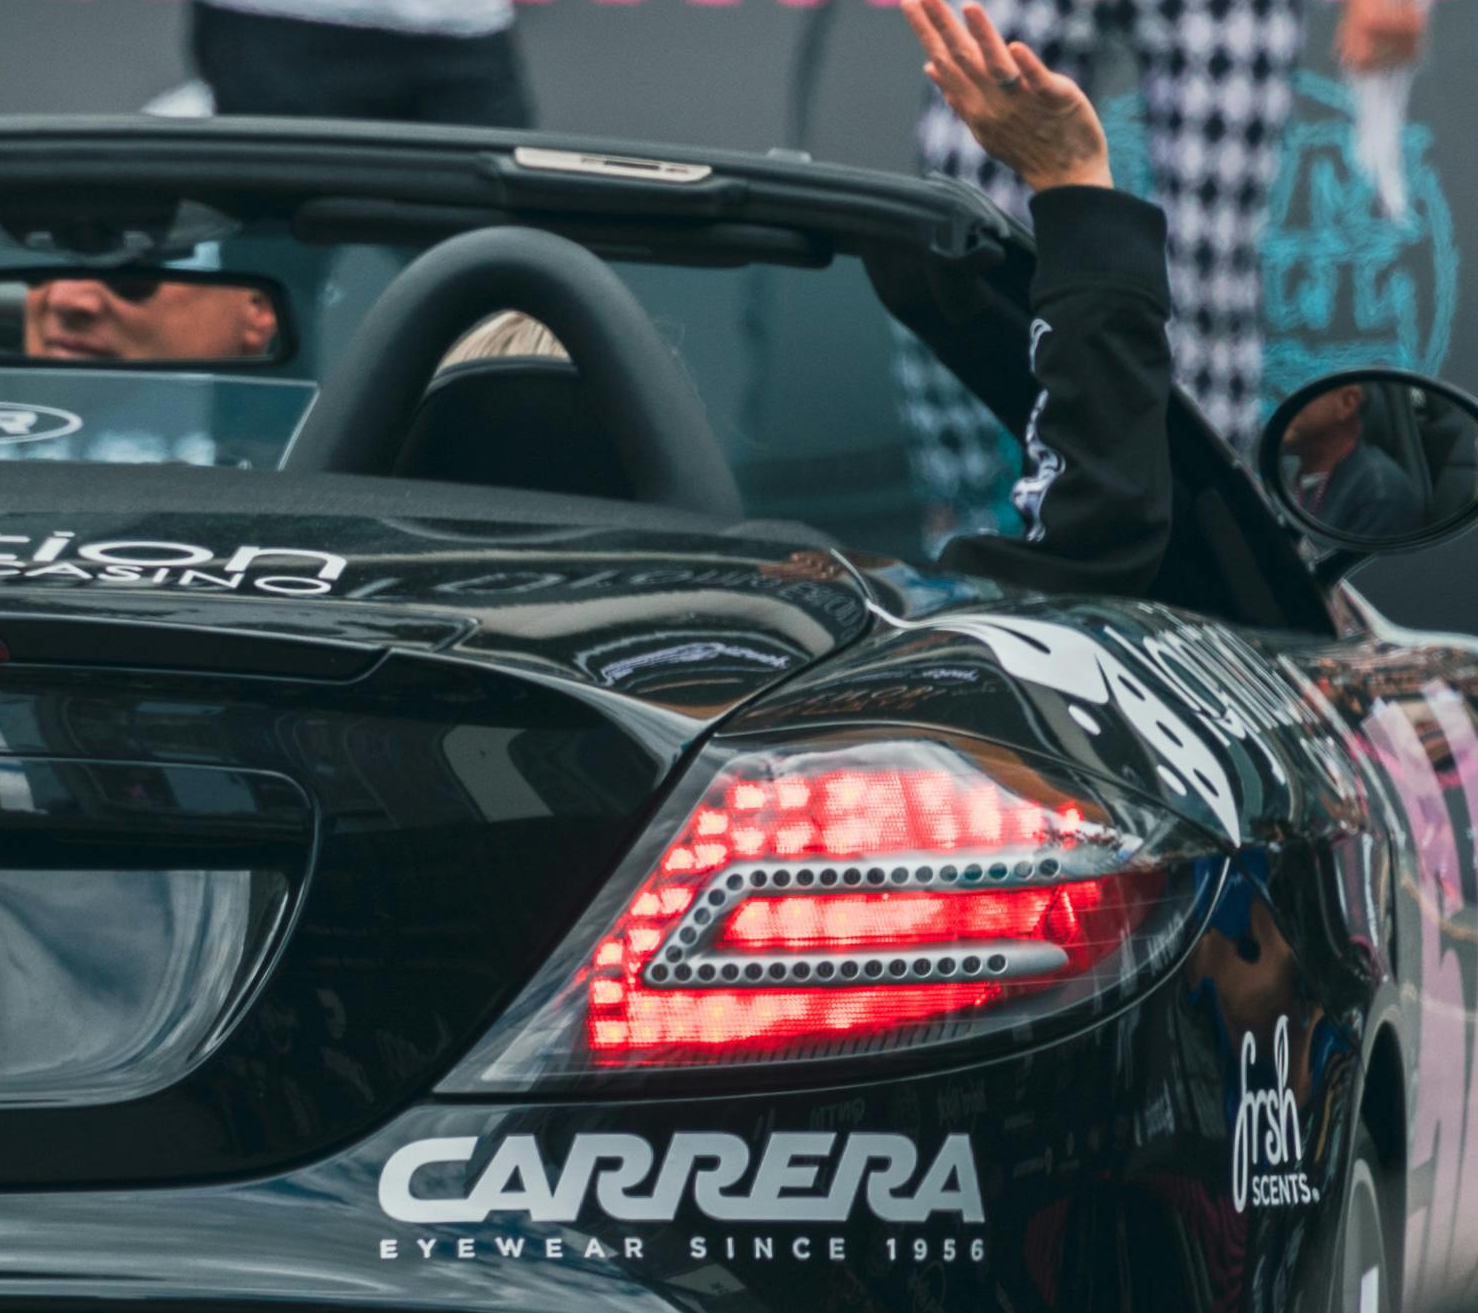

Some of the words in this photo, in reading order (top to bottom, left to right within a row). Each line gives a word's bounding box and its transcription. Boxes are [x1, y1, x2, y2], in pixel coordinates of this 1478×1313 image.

[1232, 1013, 1303, 1214] frsh
[378, 1131, 986, 1223] CARRERA
[380, 1237, 643, 1260] EYEWEAR
[690, 1236, 846, 1261] SINCE
[885, 1237, 985, 1262] 1956
